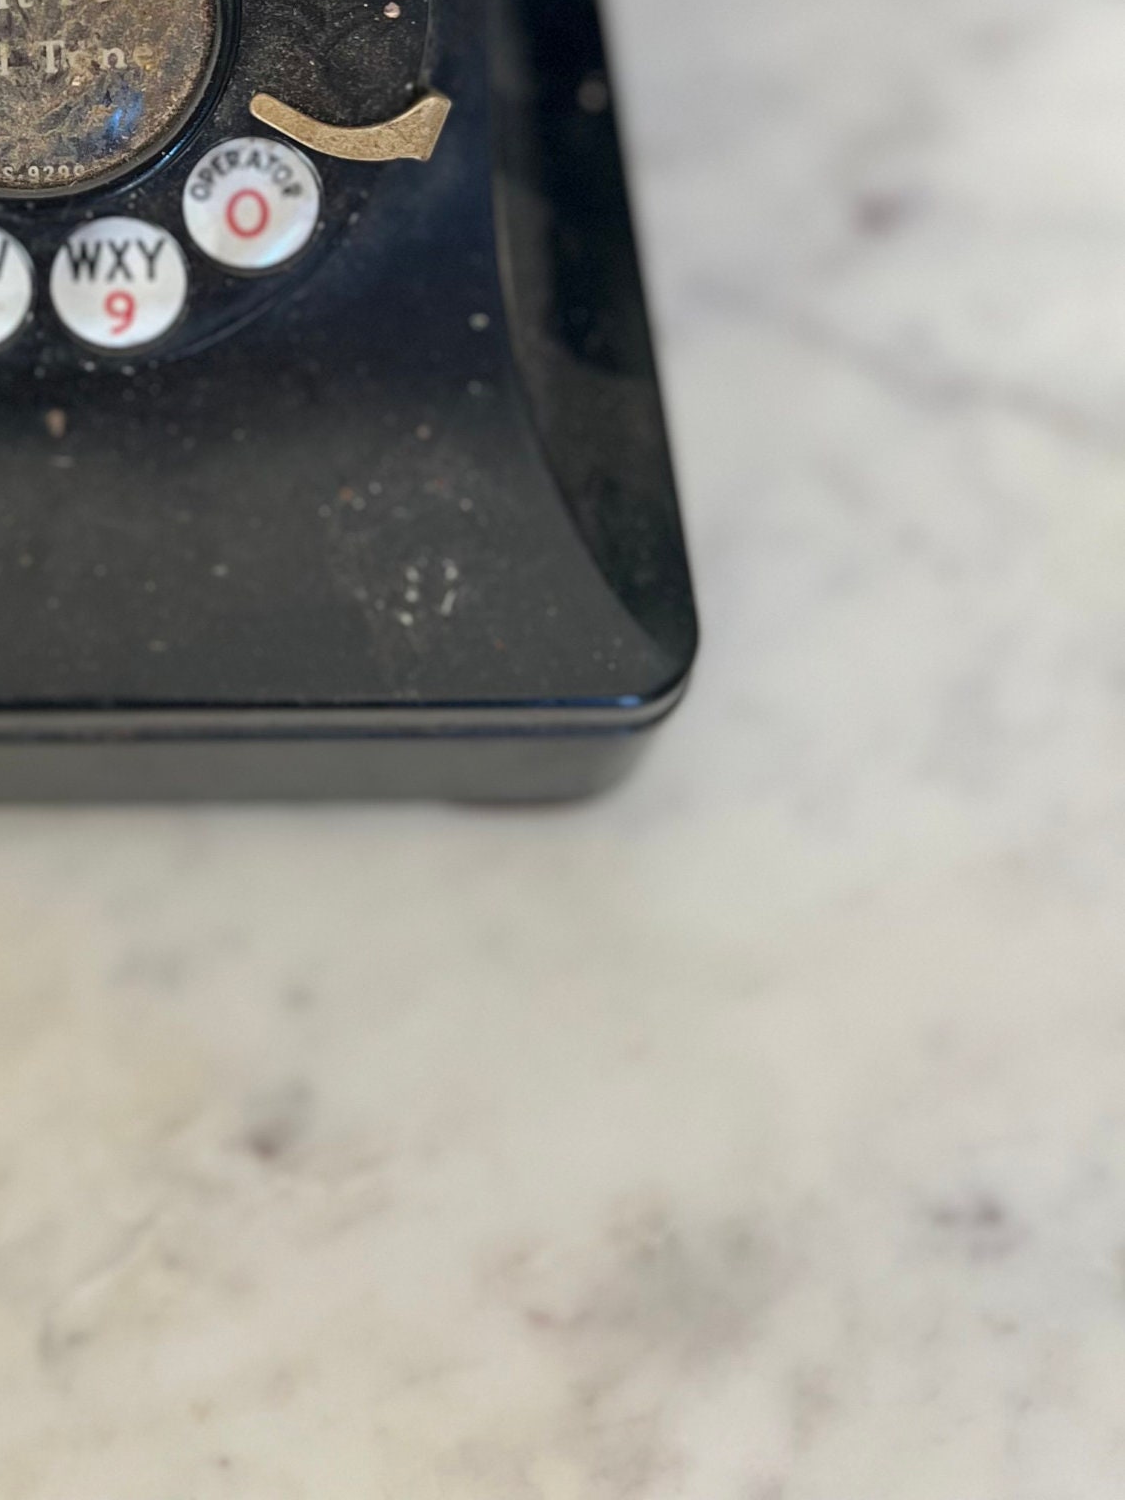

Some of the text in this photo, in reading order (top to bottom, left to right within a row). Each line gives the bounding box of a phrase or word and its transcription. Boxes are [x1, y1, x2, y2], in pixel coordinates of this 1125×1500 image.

[190, 150, 302, 202] OPERATOR
[65, 237, 166, 282] WXY
[103, 290, 136, 335] 9
